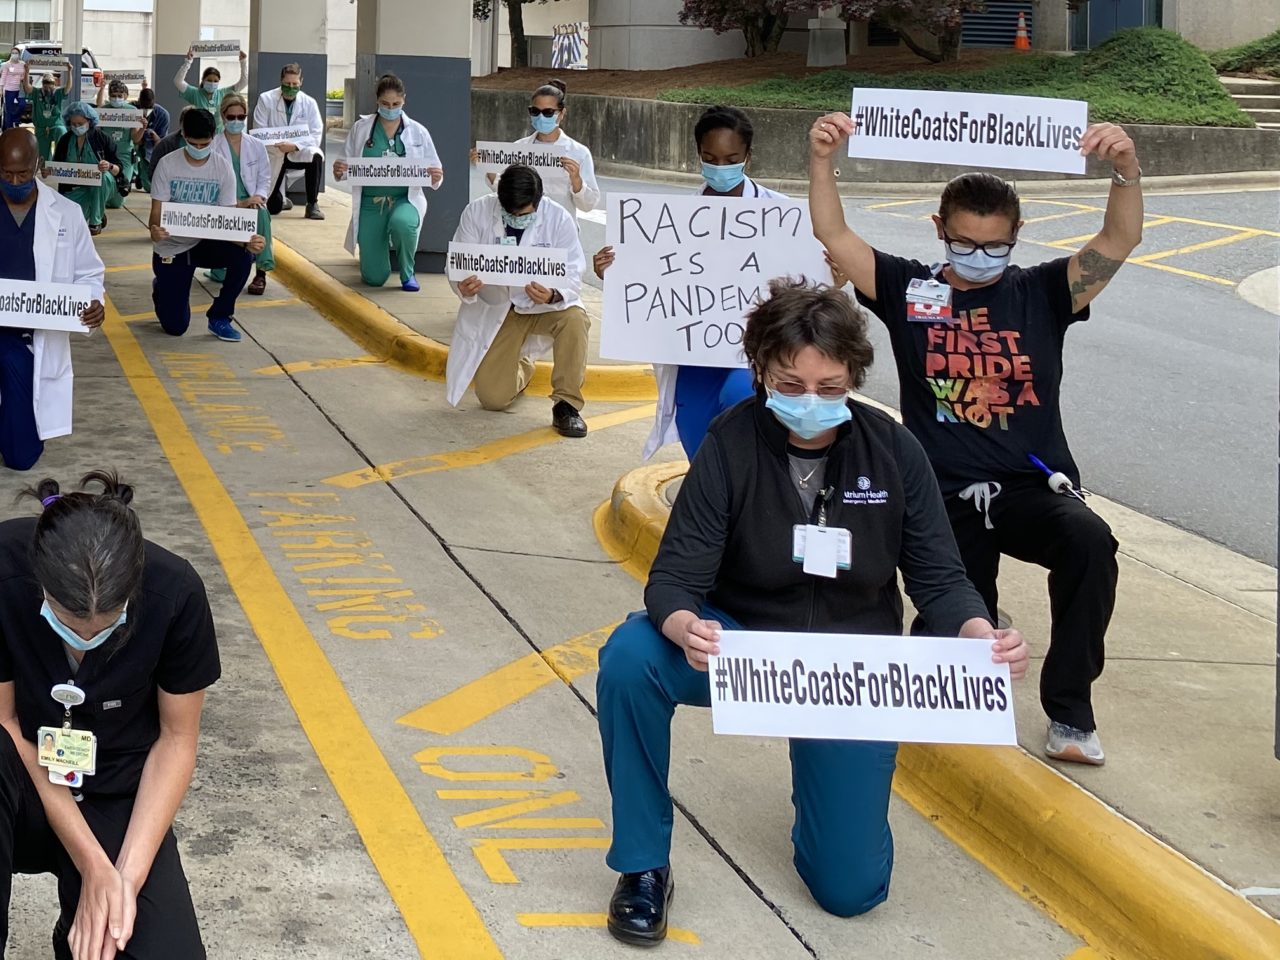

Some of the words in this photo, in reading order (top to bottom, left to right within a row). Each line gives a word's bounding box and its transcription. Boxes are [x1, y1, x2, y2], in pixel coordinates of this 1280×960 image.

[854, 105, 1082, 151] #WhiteCoatsForBlackLives
[348, 164, 431, 178] #WhiteCoatsForBlackLives
[162, 209, 256, 232] #WhiteCoatsForBlackLives
[619, 197, 802, 245] RACISM
[450, 252, 566, 277] #WhiteCoatsForBlackLives
[659, 251, 705, 277] IS
[739, 251, 761, 274] A
[624, 281, 761, 324] PANDEM
[933, 307, 991, 331] HE
[676, 320, 746, 352] TOO
[927, 327, 1021, 354] FIRST
[926, 352, 1034, 380] PRIDE
[1016, 381, 1041, 406] A
[935, 399, 1015, 431] RIOT
[866, 489, 889, 499] Health
[248, 492, 446, 640] PARKING
[715, 657, 1008, 712] #WhiteCoatsForBlackLives
